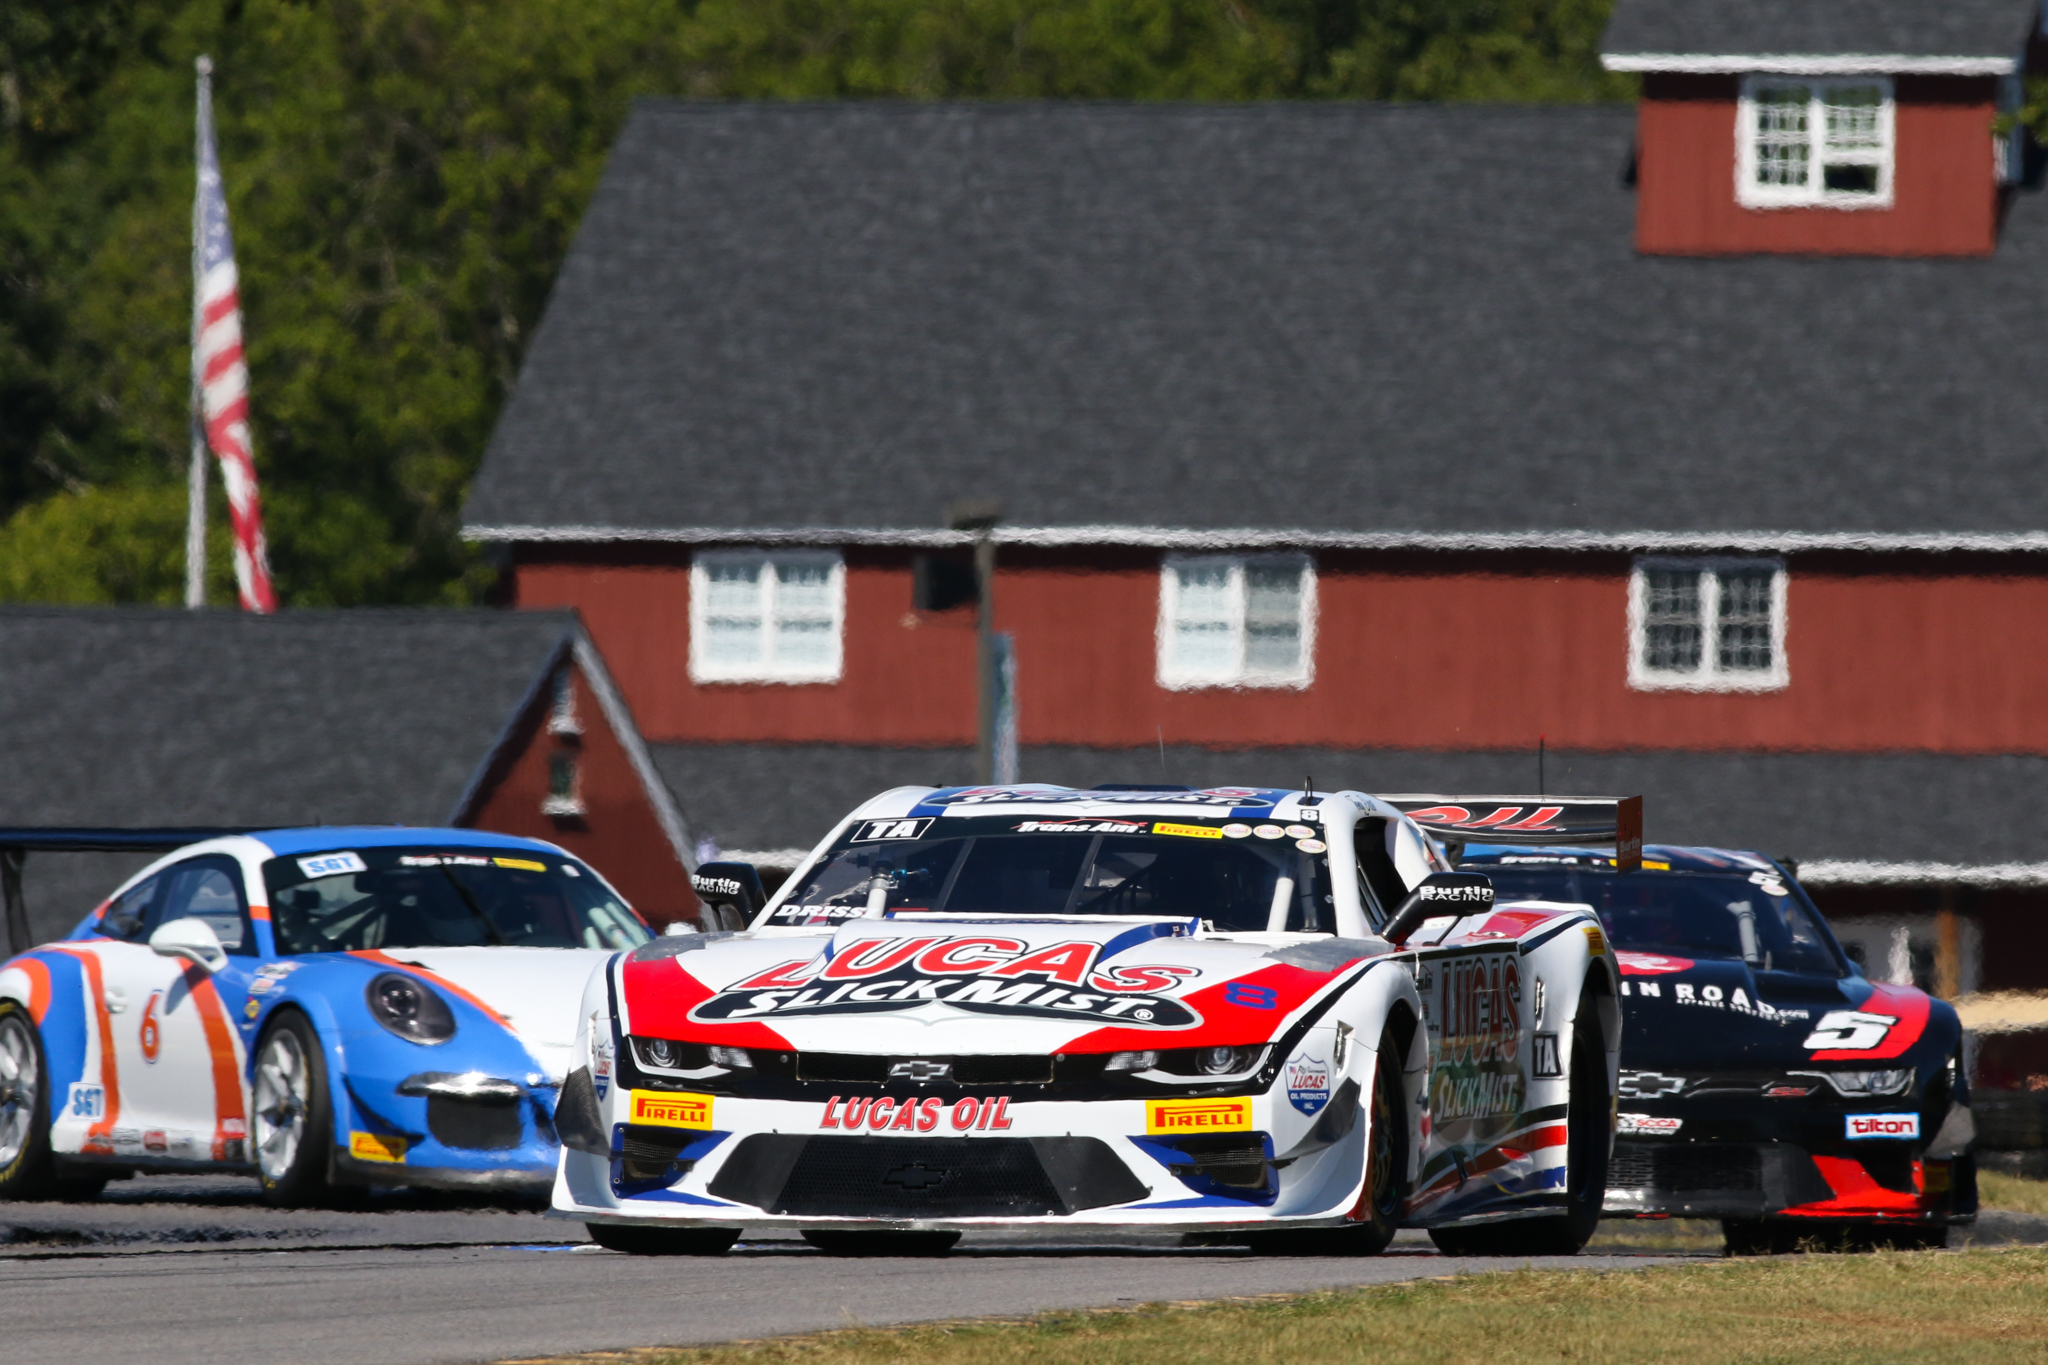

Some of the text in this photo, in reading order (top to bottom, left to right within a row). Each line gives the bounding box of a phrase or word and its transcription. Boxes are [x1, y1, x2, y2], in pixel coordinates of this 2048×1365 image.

[1301, 810, 1319, 821] 8
[868, 821, 918, 839] TA
[1017, 821, 1091, 833] Trans
[1092, 822, 1139, 833] Am
[307, 857, 354, 873] SGT
[691, 874, 741, 889] Burtin
[1420, 886, 1494, 895] Burtin
[1420, 893, 1493, 902] RACING
[738, 936, 1201, 995] LUCAS
[1224, 982, 1278, 1010] 8
[1438, 955, 1521, 1068] LUCAS
[139, 989, 162, 1064] 6
[1803, 1011, 1897, 1049] 5
[1534, 1037, 1558, 1074] TA
[1292, 1075, 1326, 1089] LUCAS
[636, 1098, 706, 1122] PIRELLI
[819, 1095, 1012, 1132] LUCAS OIL
[1155, 1104, 1243, 1127] PIRELLI
[1636, 1119, 1678, 1127] SCCA
[1852, 1118, 1914, 1133] tilton
